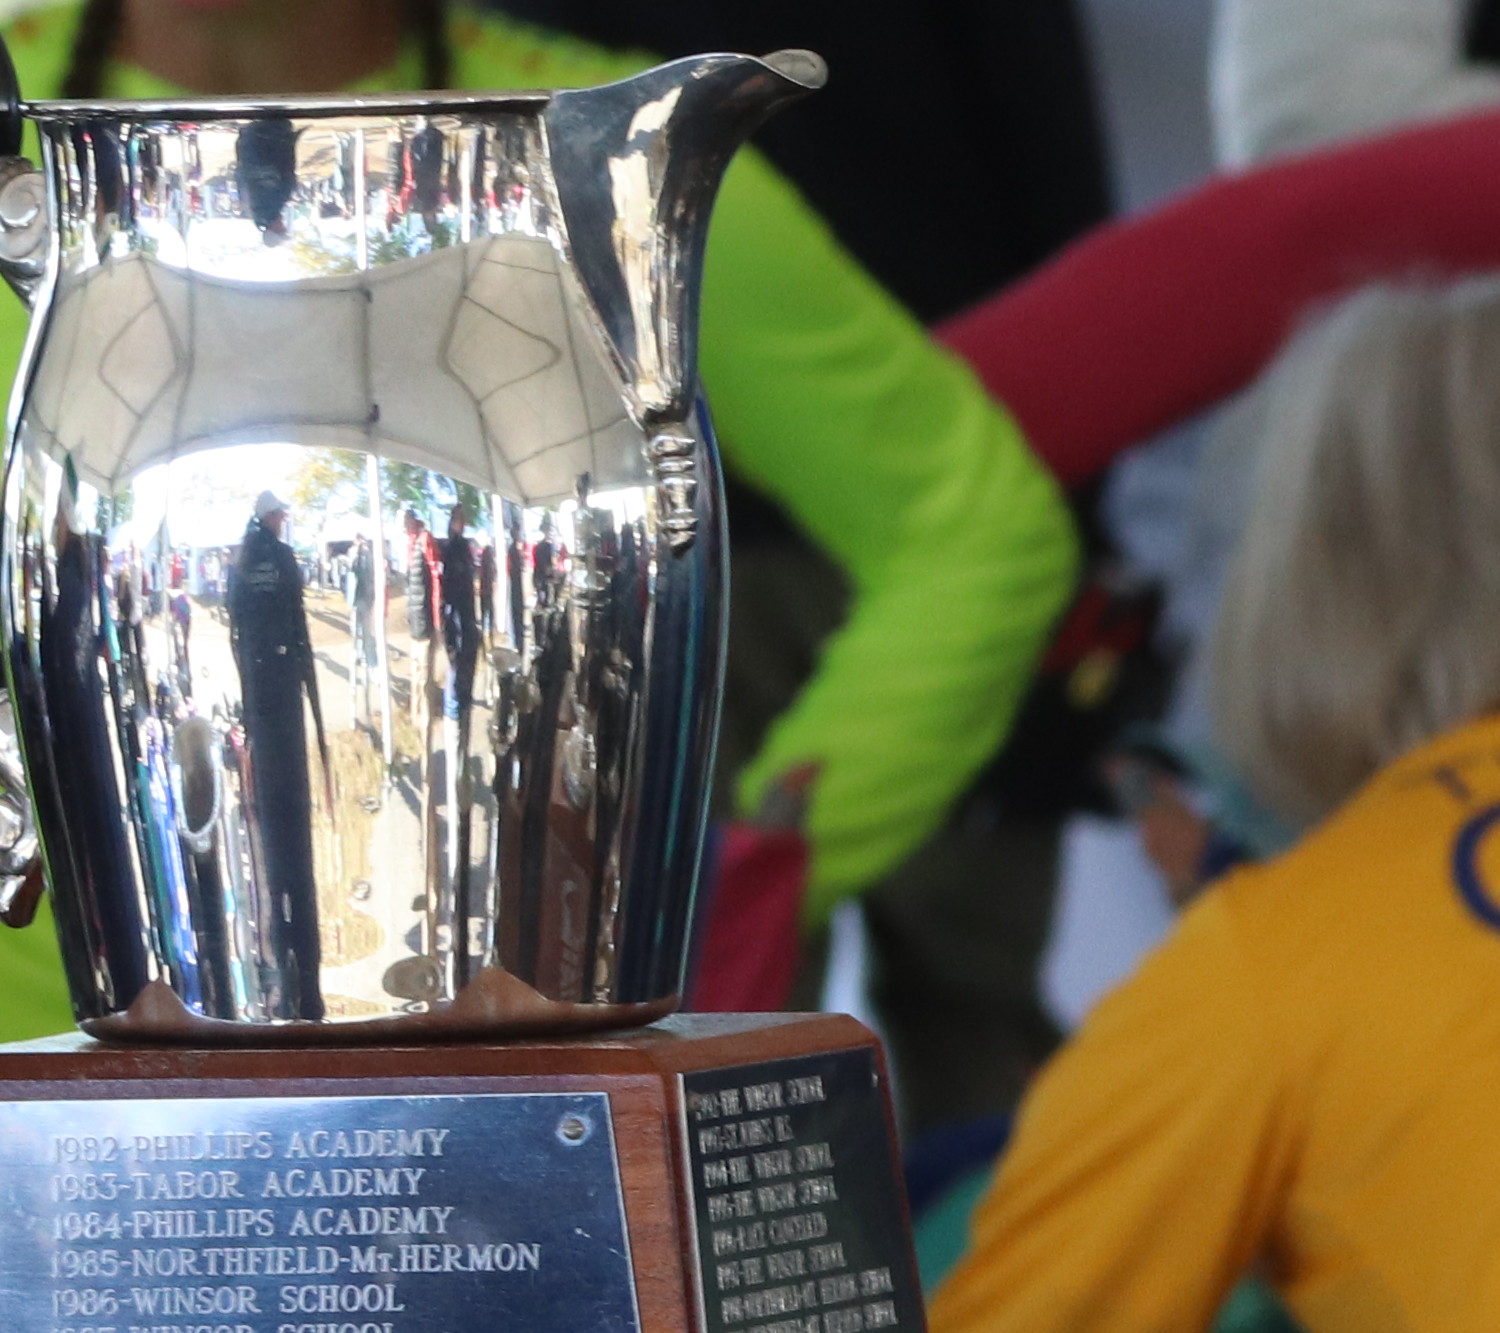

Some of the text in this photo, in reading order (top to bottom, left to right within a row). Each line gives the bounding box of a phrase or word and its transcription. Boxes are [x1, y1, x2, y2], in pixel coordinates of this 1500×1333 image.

[53, 1129, 449, 1163] 1982-PHILLIPS ACADEMY
[53, 1168, 426, 1201] 1983-TABOR ACADEMY
[53, 1206, 454, 1240] 1984-PHILLIPS ACADEMY
[52, 1284, 405, 1316] 1986-WINSOR SCHOOL
